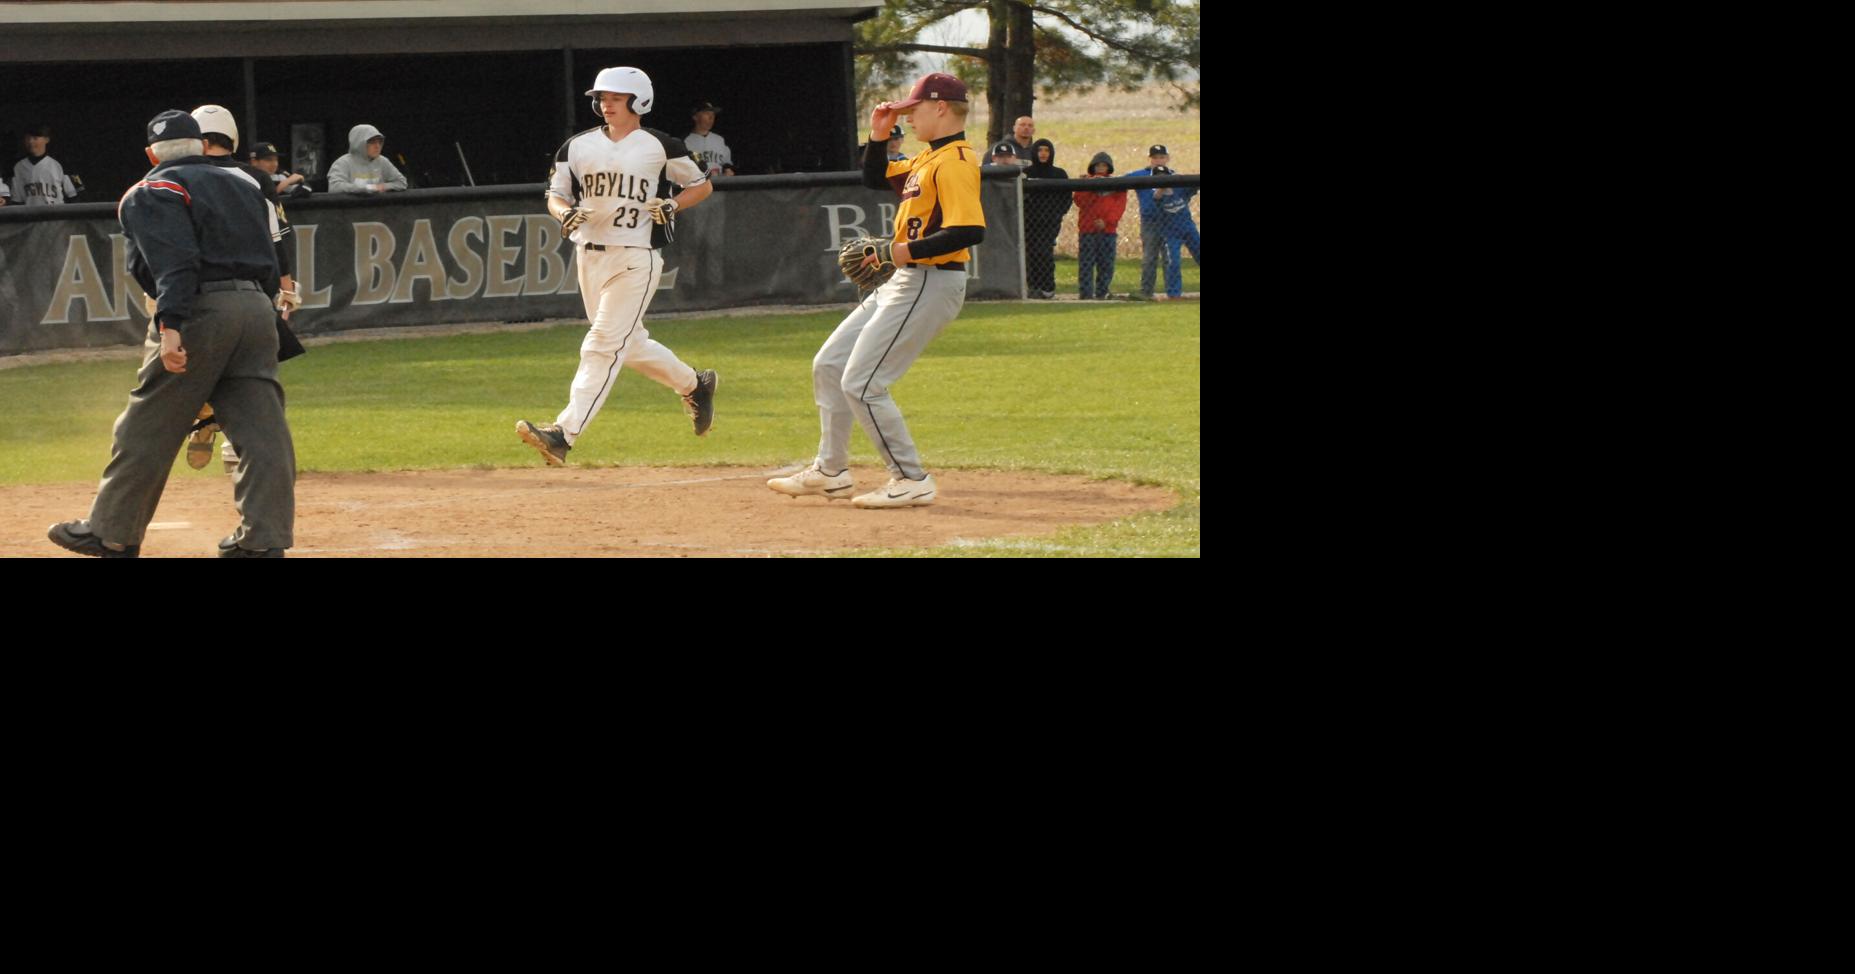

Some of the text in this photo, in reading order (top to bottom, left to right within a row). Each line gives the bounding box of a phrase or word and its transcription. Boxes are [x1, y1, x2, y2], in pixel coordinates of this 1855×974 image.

[613, 206, 640, 229] 23
[907, 217, 922, 240] 8
[352, 213, 680, 306] BASEB
